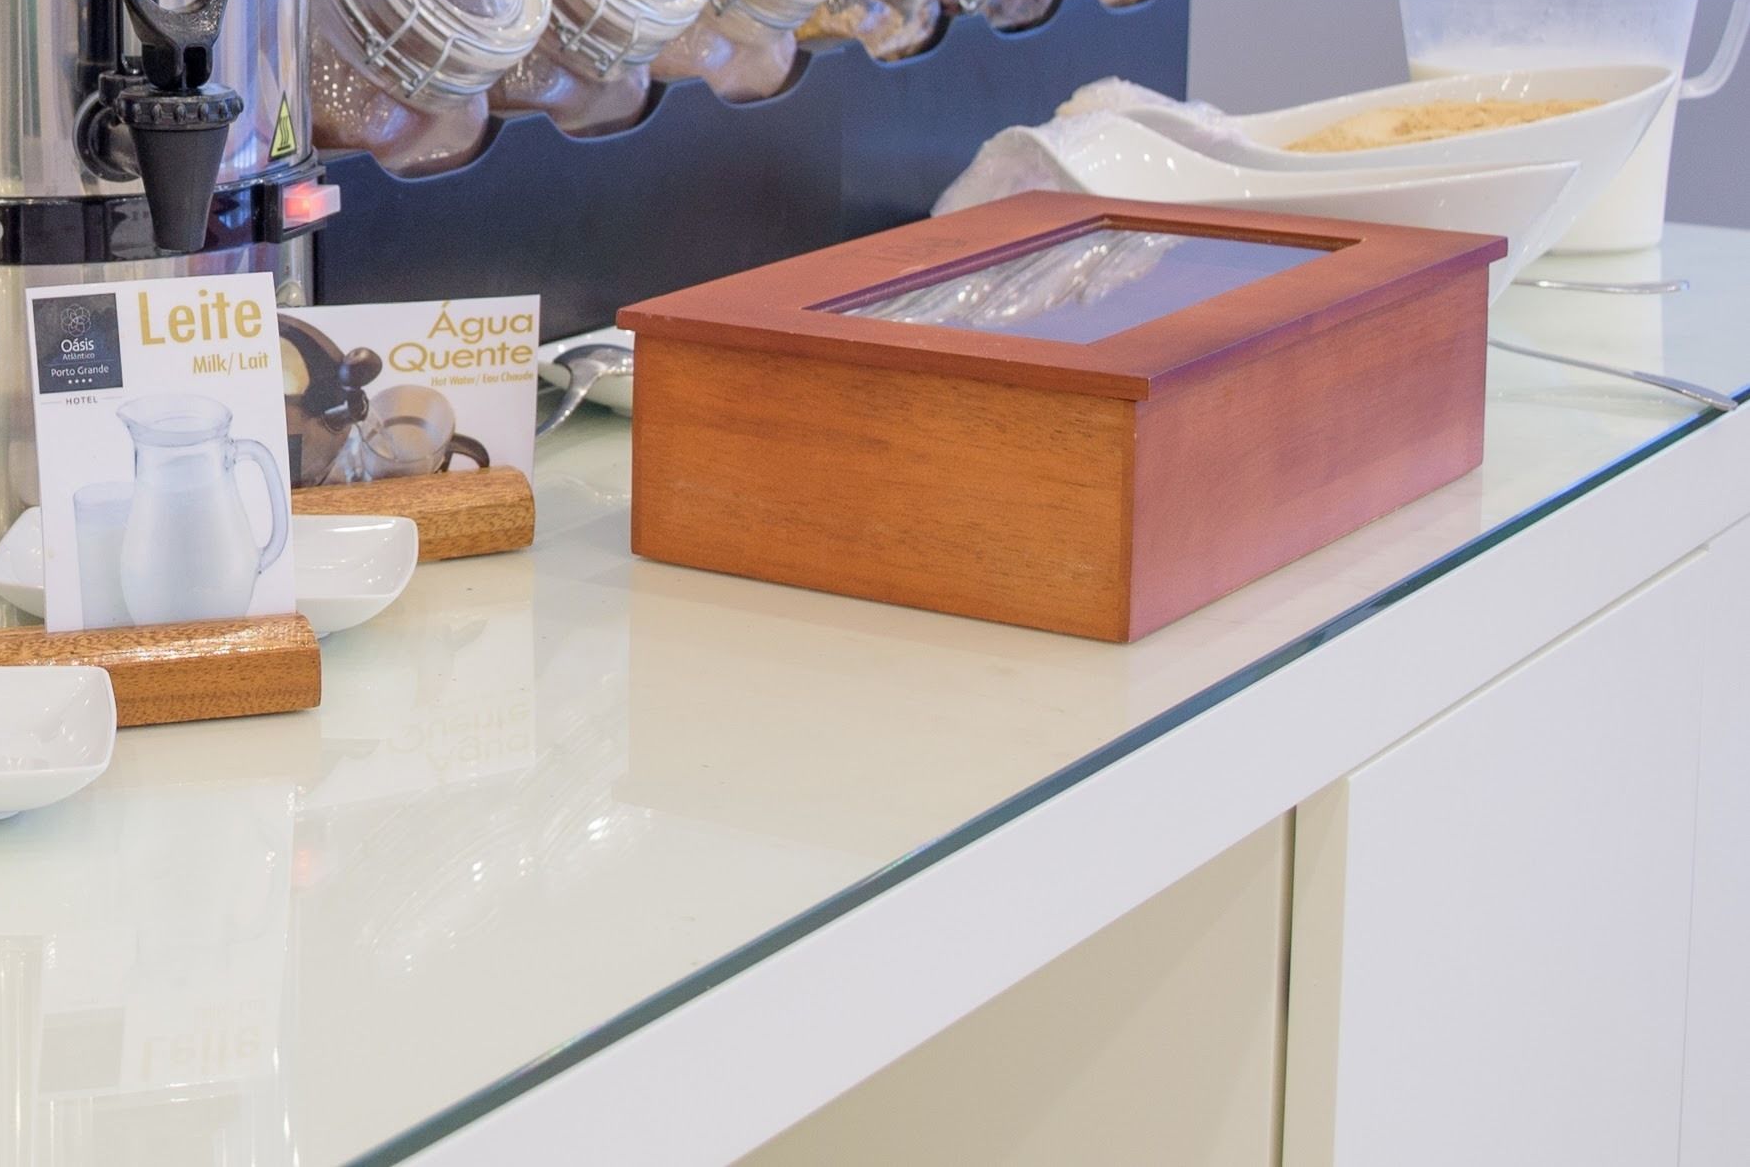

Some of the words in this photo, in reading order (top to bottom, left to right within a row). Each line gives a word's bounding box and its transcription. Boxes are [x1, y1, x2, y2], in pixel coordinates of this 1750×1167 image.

[138, 290, 262, 345] Leite
[427, 301, 533, 344] Água
[60, 337, 95, 353] Oásis
[239, 352, 269, 371] Lait
[388, 342, 533, 373] Quente
[51, 366, 76, 378] Porto
[77, 364, 109, 376] Grande
[431, 377, 447, 387] Hot
[66, 396, 98, 406] HOTEL
